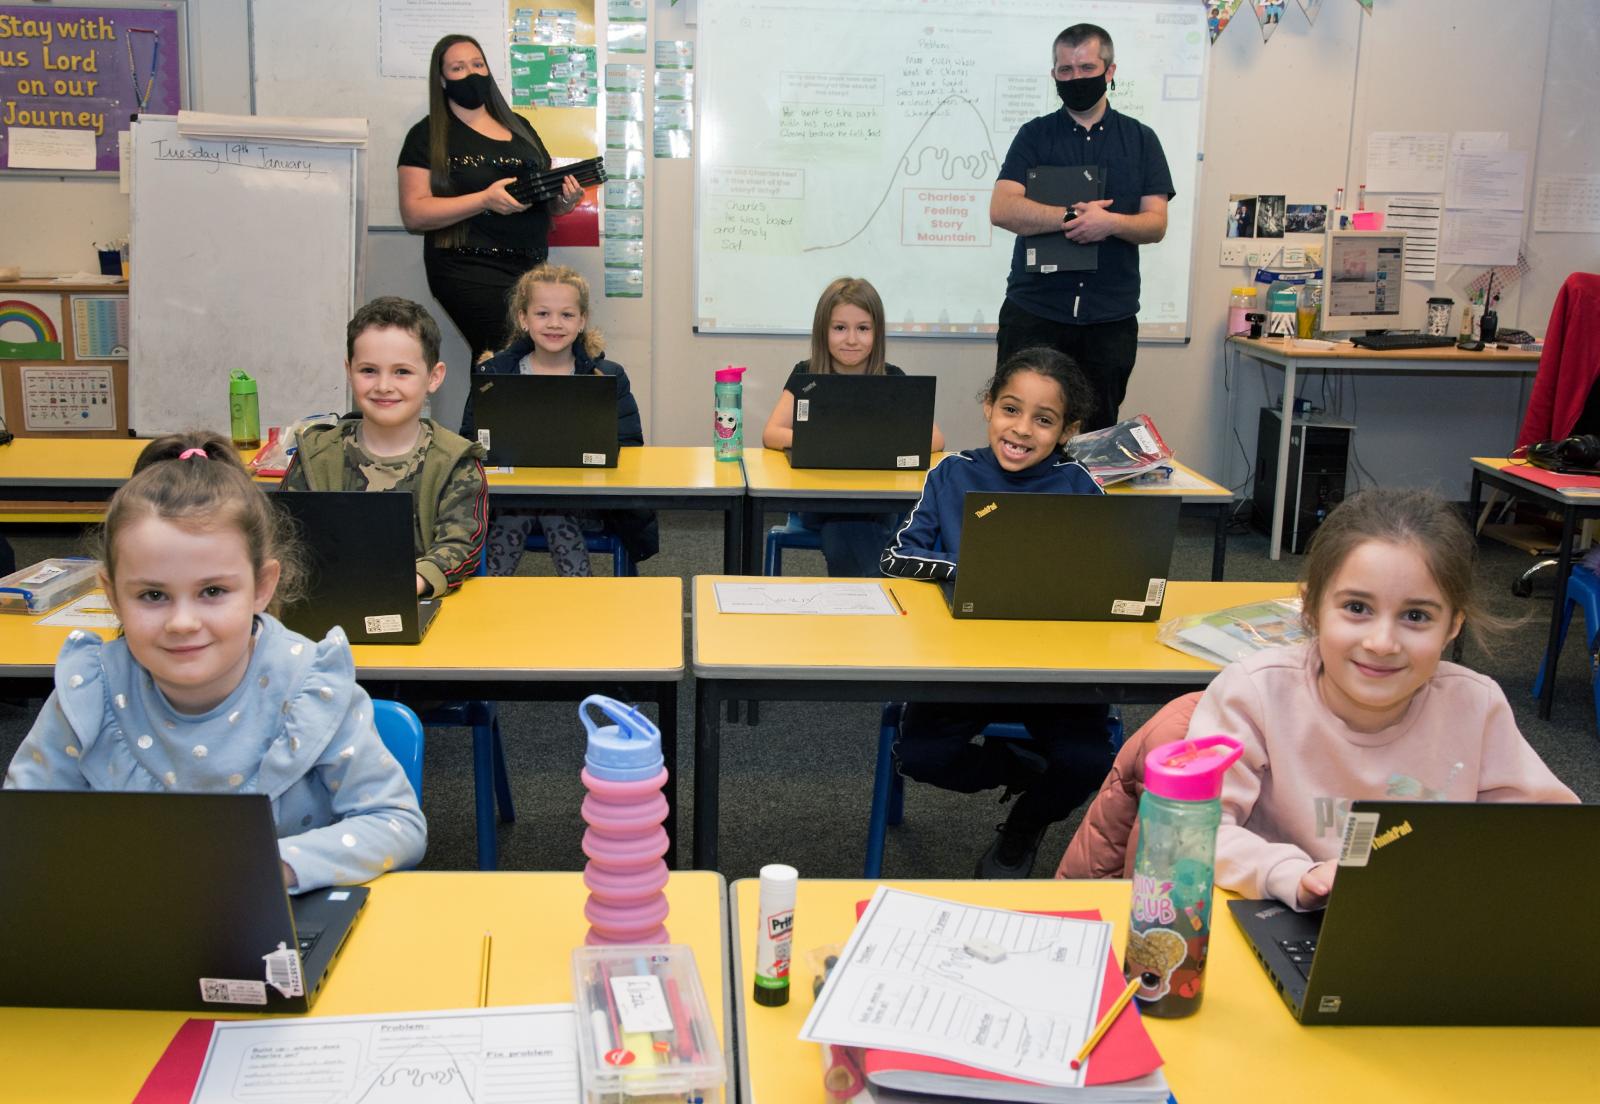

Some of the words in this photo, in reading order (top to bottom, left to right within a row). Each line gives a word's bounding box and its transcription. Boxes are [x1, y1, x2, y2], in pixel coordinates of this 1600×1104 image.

[0, 15, 52, 45] Stay
[57, 16, 116, 41] with
[0, 51, 30, 67] us
[43, 46, 98, 73] Lord
[17, 79, 49, 96] on
[54, 79, 99, 97] our
[3, 101, 104, 136] Journey
[151, 139, 219, 174] Tuesday
[225, 142, 249, 164] 19th
[257, 146, 312, 180] January
[917, 192, 976, 202] Charles's
[923, 206, 969, 218] Feeling
[741, 216, 761, 226] was
[930, 219, 963, 231] Story
[713, 225, 735, 235] and
[917, 232, 976, 242] Mountain
[974, 501, 999, 518] ThinkPad
[1134, 895, 1177, 925] CLUB
[508, 1048, 553, 1061] problem
